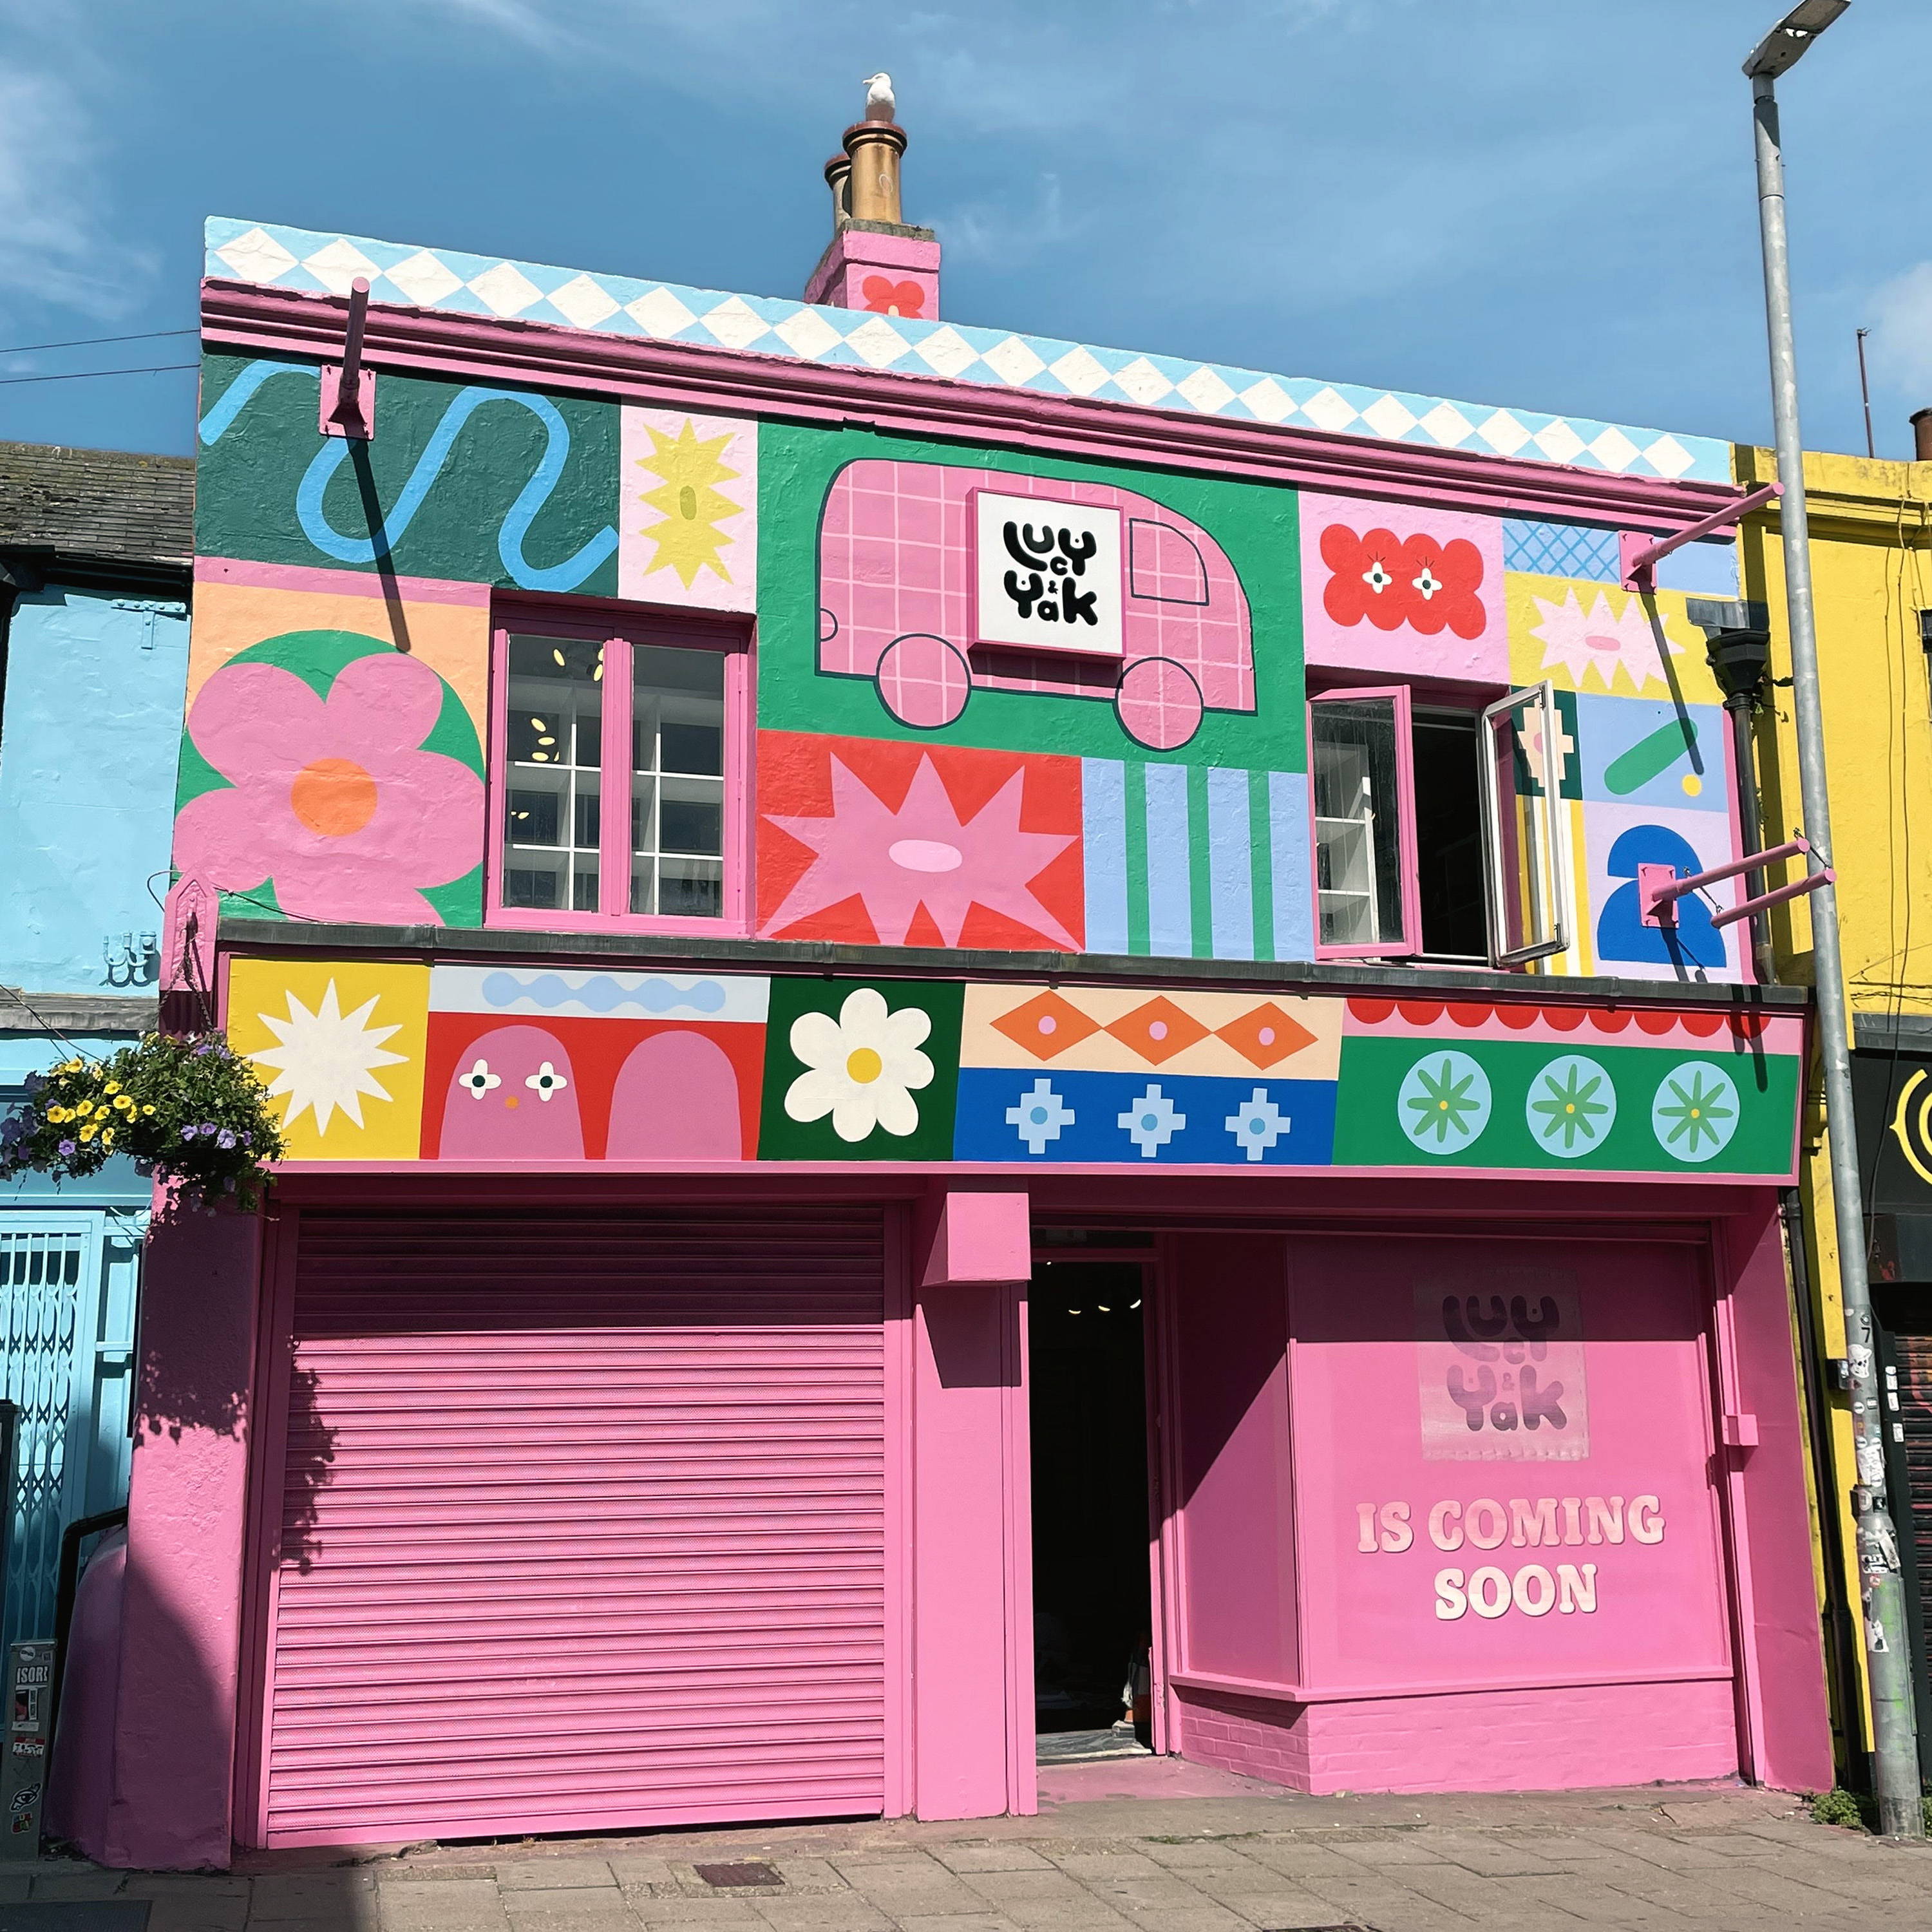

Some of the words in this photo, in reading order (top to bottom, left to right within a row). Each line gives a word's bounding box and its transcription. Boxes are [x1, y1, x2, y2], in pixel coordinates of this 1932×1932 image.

[1003, 570, 1098, 626] Yak
[1048, 580, 1058, 594] &
[1861, 1327, 1870, 1343] 7
[1446, 1365, 1567, 1431] Yak
[1502, 1372, 1514, 1391] &
[1356, 1501, 1414, 1553] IS
[1428, 1495, 1665, 1551] COMING
[1434, 1564, 1598, 1621] SOON
